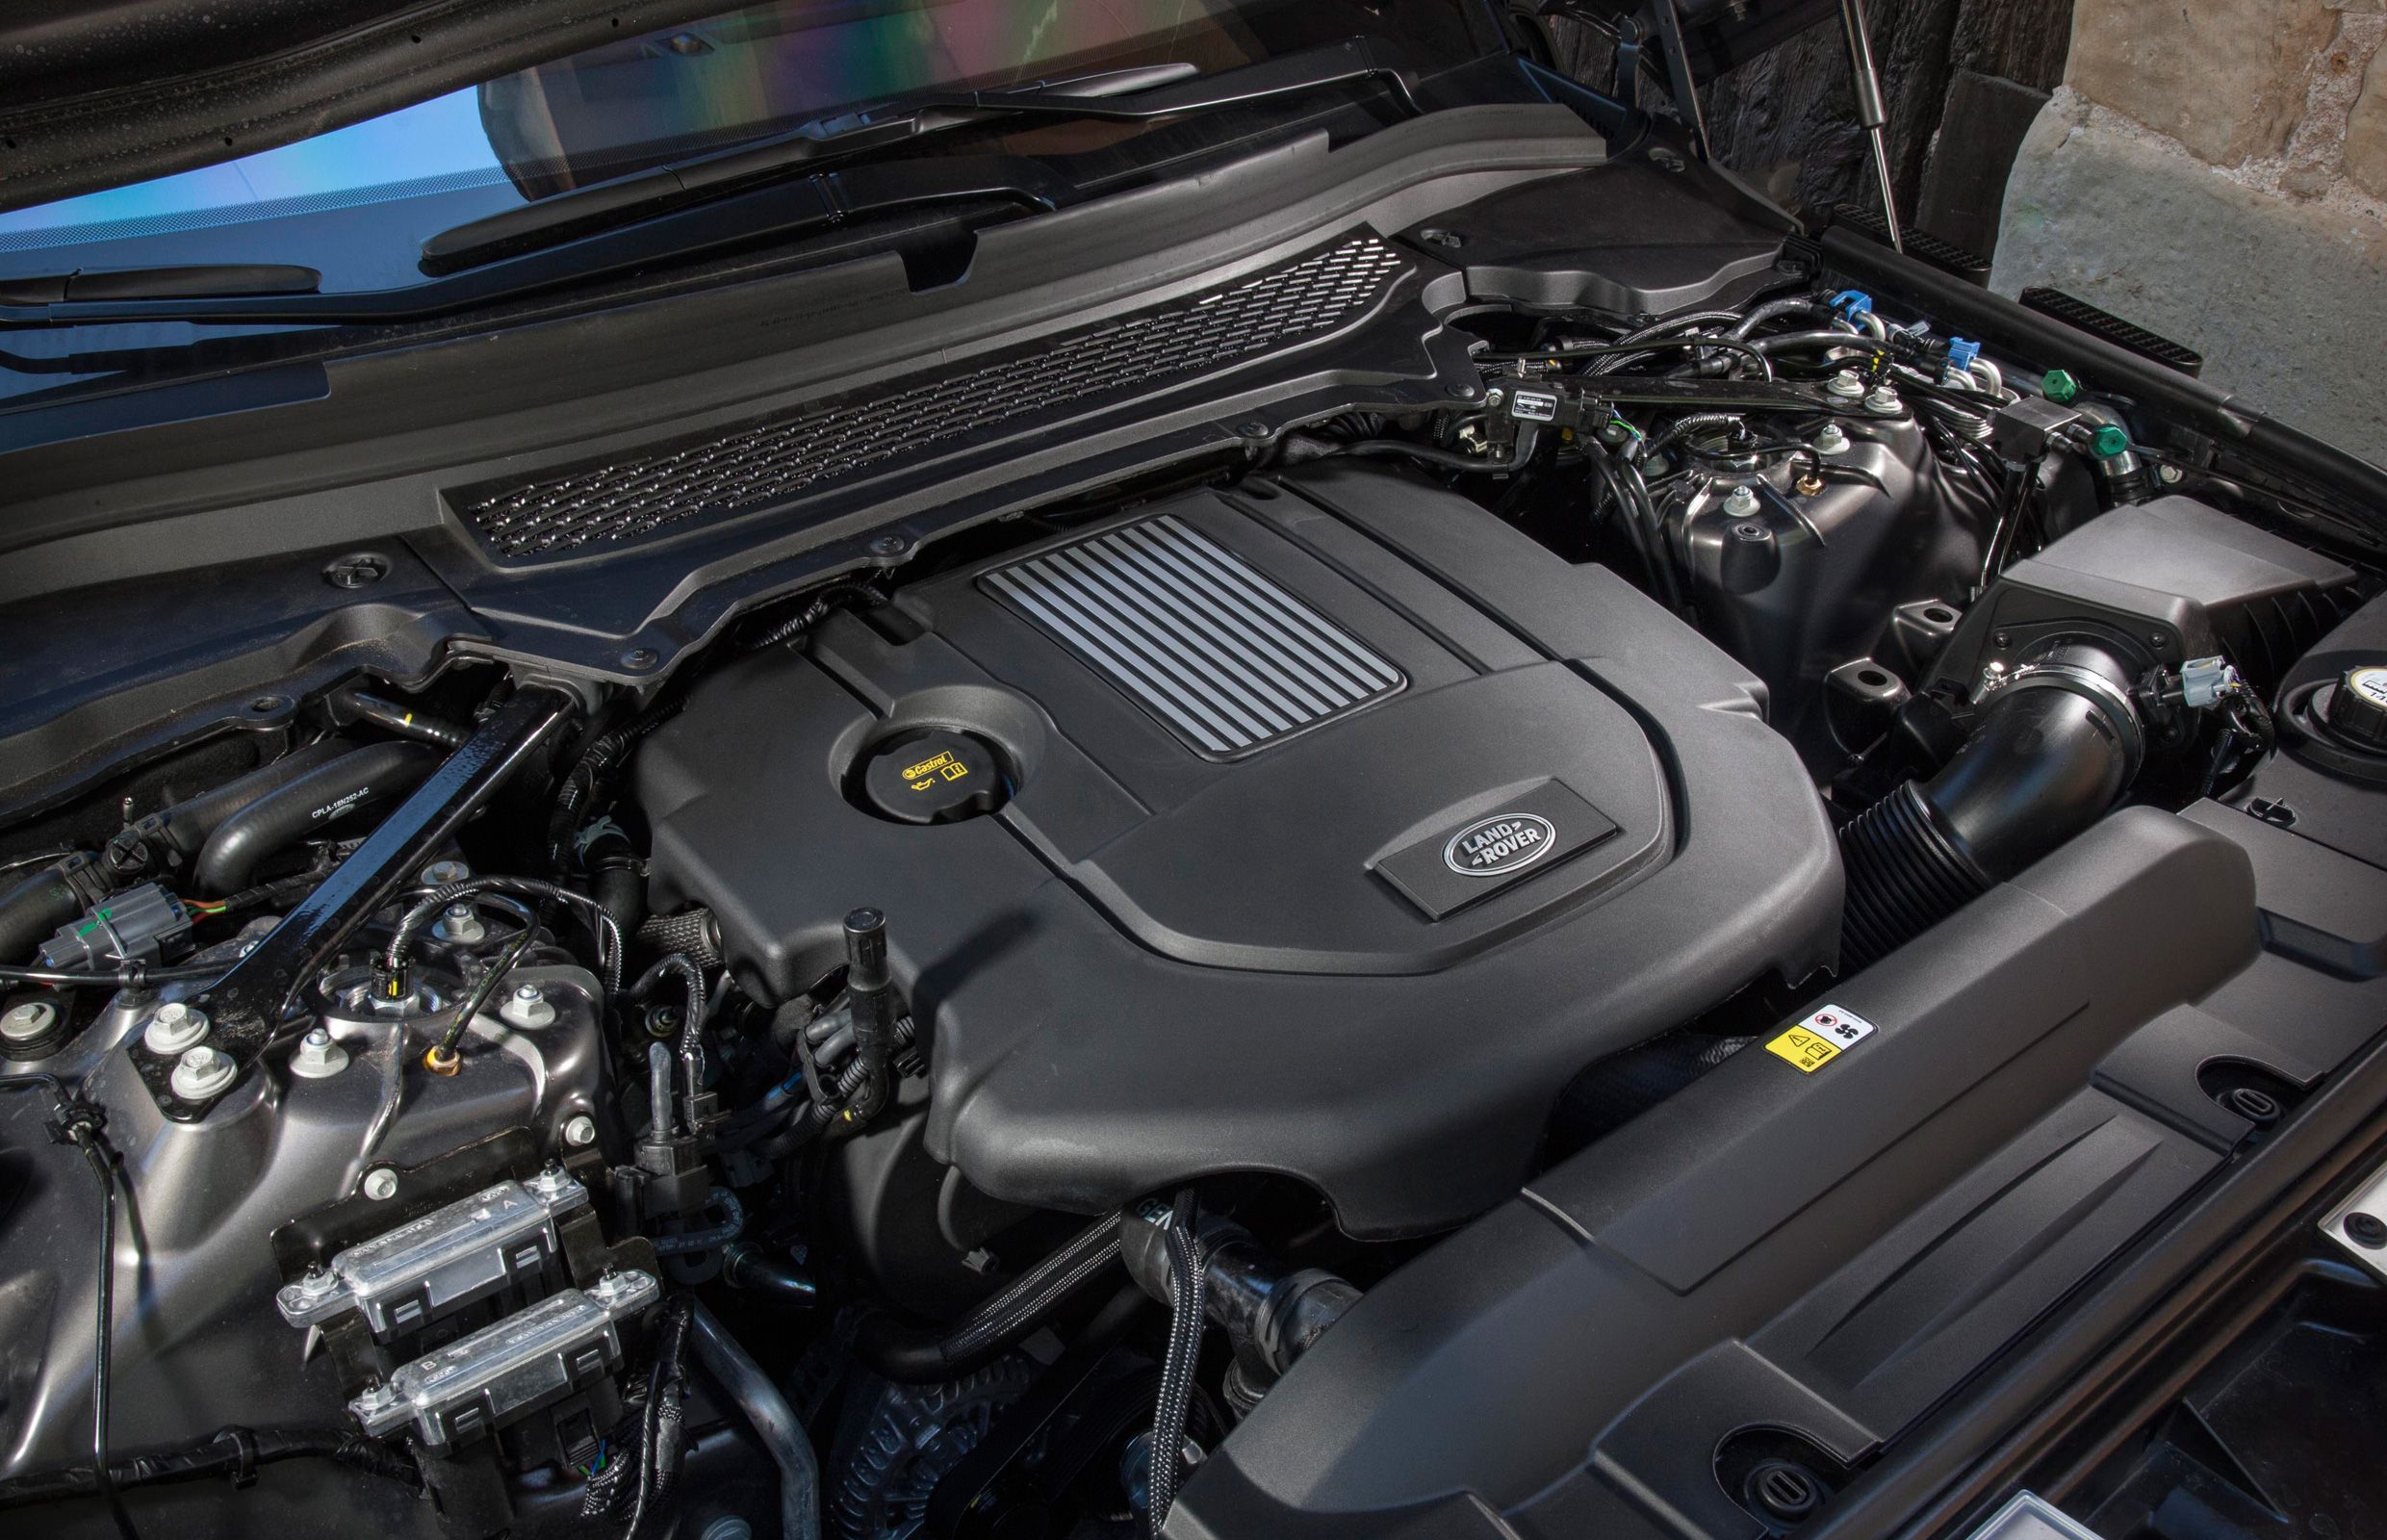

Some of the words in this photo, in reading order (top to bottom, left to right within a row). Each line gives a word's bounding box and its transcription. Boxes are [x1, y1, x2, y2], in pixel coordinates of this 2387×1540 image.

[915, 755, 948, 775] Castrol
[1461, 823, 1513, 855] LAND
[1479, 828, 1541, 864] ROVER
[502, 1199, 519, 1210] A
[421, 1360, 437, 1371] B
